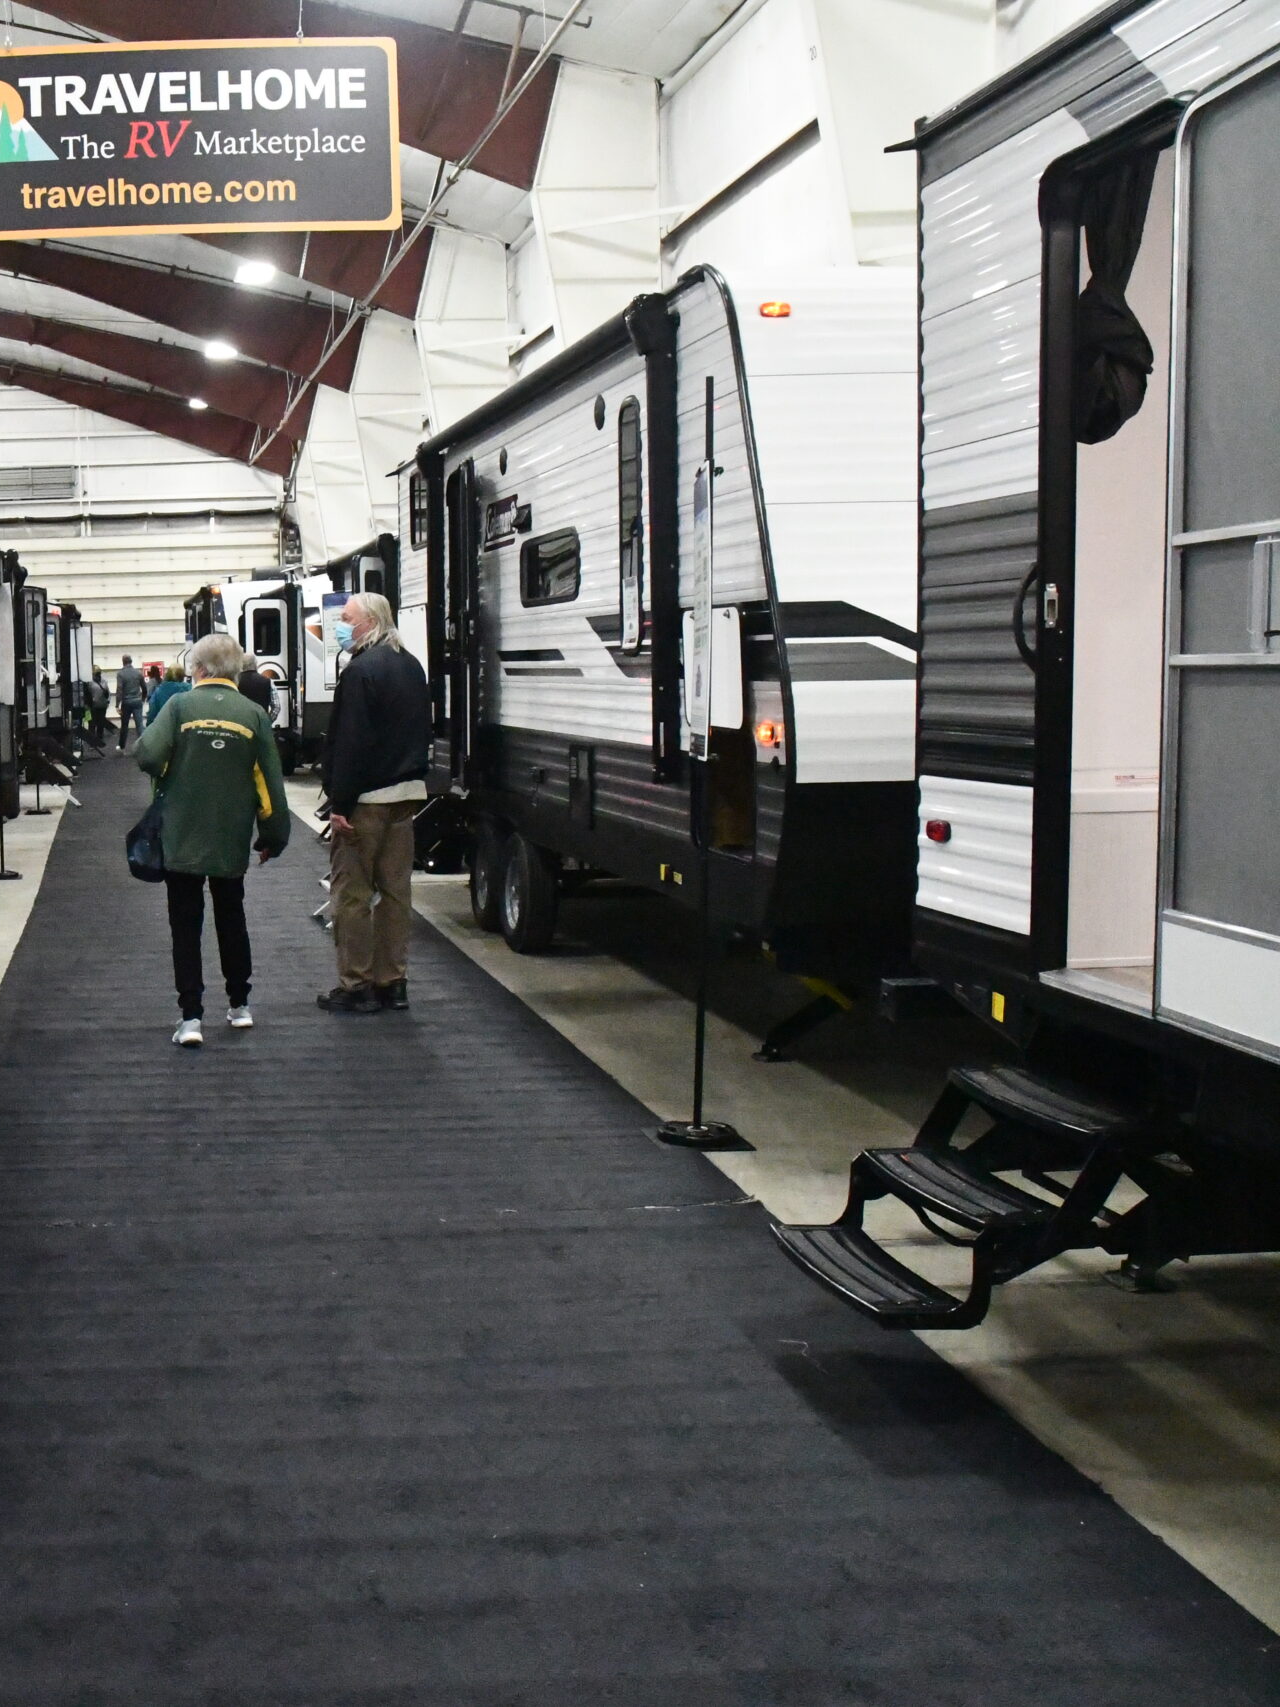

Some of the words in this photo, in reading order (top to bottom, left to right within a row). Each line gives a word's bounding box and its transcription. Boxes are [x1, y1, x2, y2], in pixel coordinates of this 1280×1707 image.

[18, 68, 366, 118] TRAVELHOME
[60, 134, 115, 162] The
[124, 119, 192, 159] RV
[194, 128, 366, 162] Marketplace
[21, 177, 297, 210] travelhome.com
